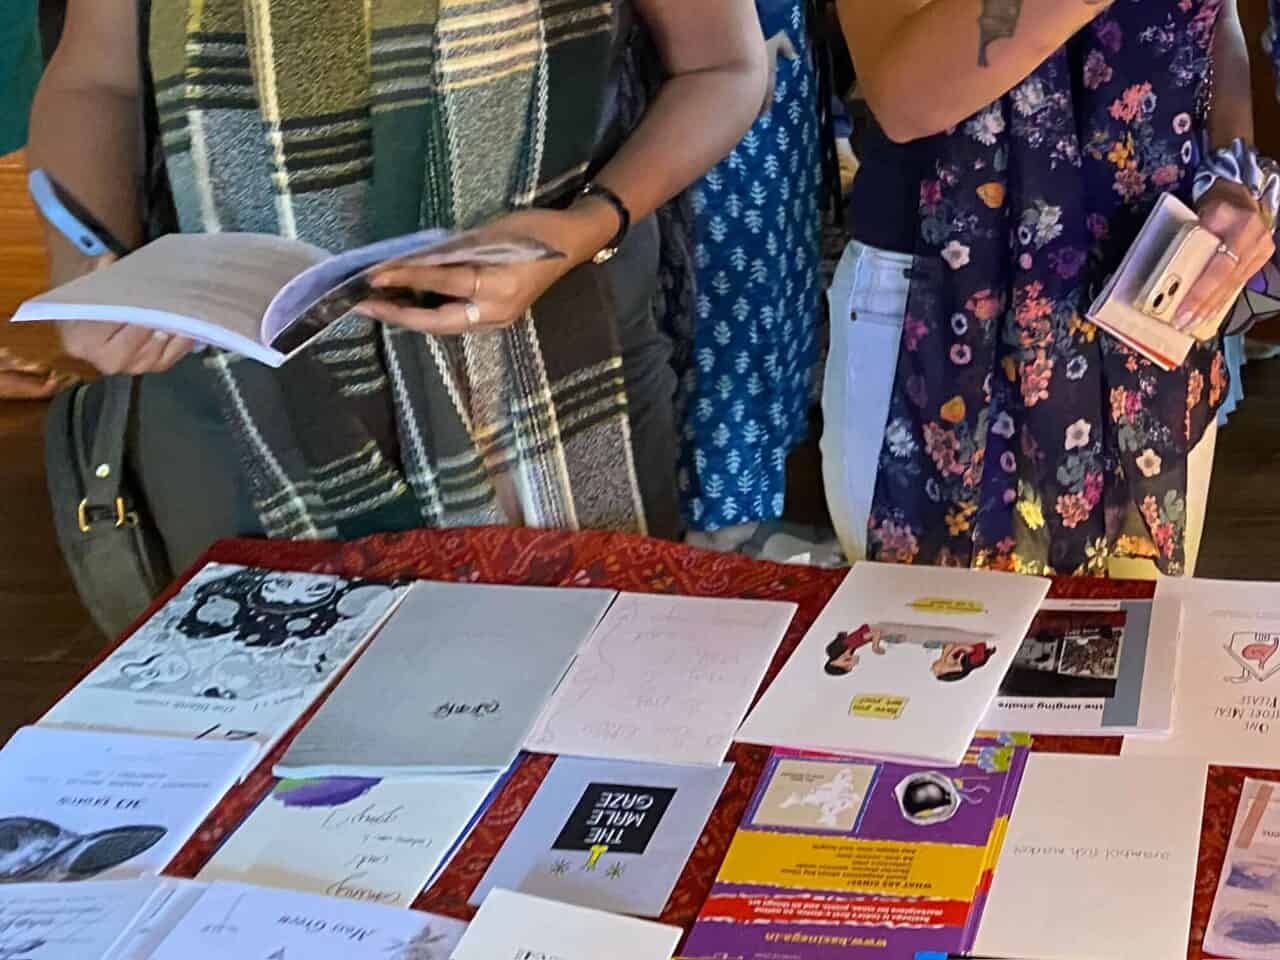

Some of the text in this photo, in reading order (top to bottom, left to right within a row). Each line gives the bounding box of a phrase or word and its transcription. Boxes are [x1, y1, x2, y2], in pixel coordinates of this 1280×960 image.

[594, 791, 654, 810] GAZE
[585, 809, 646, 827] MALE
[583, 826, 625, 844] THE
